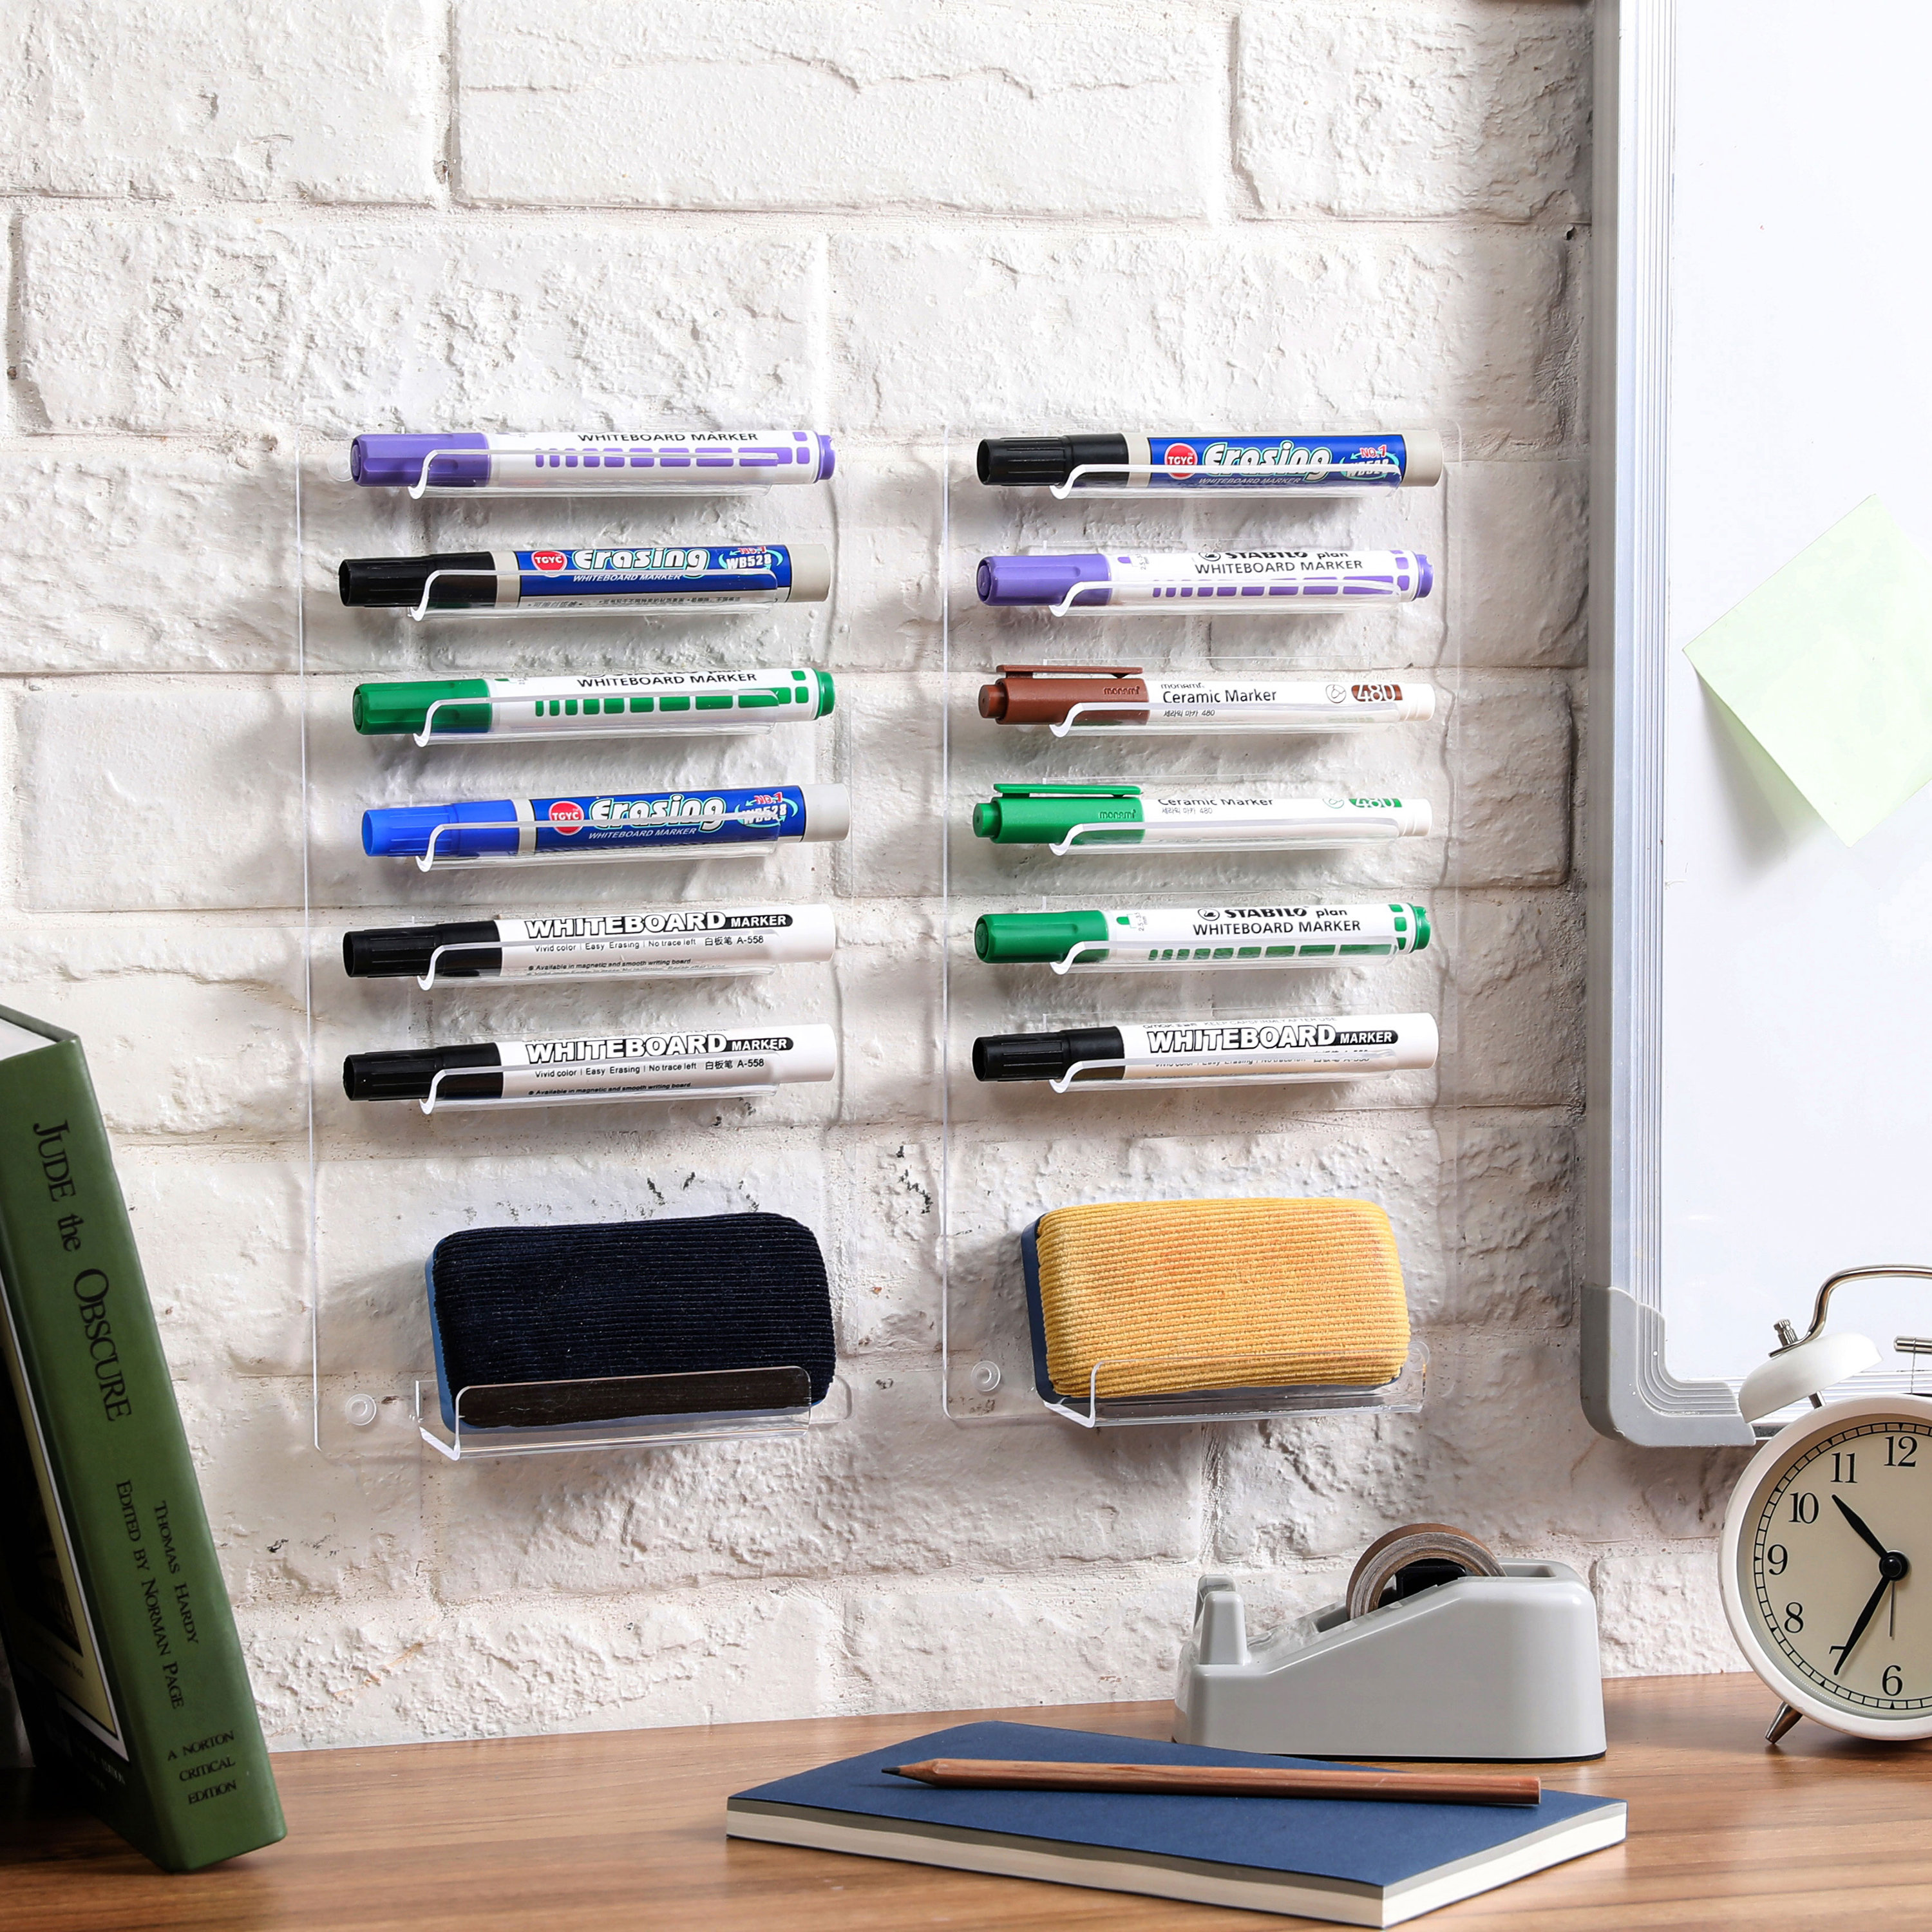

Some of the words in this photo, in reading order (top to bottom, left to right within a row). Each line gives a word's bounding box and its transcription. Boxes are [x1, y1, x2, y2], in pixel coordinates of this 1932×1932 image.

[577, 434, 685, 443] WHITEBOARD
[691, 432, 759, 442] MARKER
[1204, 440, 1332, 481] Erasing
[573, 547, 710, 578] Erasing
[726, 554, 772, 569] WB528
[1195, 562, 1295, 574] WHITEBOARD
[1300, 560, 1363, 571] MARKER
[577, 676, 685, 687] WHITEBOARD
[690, 674, 757, 683] MARKER
[1163, 690, 1221, 703] Ceramic
[1226, 688, 1276, 703] Marker
[1357, 685, 1396, 702] 480
[591, 794, 725, 831] Erasing
[1220, 797, 1274, 806] Marker
[588, 829, 653, 839] WHITEBOARD
[654, 828, 697, 837] MARKER
[524, 912, 728, 938] WHITEBOARD
[730, 914, 788, 928] MARKER
[1224, 907, 1307, 918] STABILO
[1316, 907, 1348, 918] plan
[736, 935, 764, 945] A-558
[1193, 921, 1294, 936] WHITEBOARD
[1298, 920, 1361, 933] MARKER
[556, 943, 577, 952] color
[585, 942, 605, 952] Easy
[609, 940, 640, 951] Erasing
[648, 940, 660, 948] No
[661, 939, 681, 947] trace
[683, 938, 697, 946] left
[705, 936, 734, 947] 白板笔
[525, 1034, 728, 1064] WHITEBOARD
[732, 1037, 788, 1051] MARKER
[1146, 1025, 1336, 1054] WHITEBOARD
[1340, 1030, 1393, 1045] MARKER
[535, 1069, 555, 1078] Vivid
[557, 1068, 577, 1077] color
[585, 1066, 605, 1077] Easy
[609, 1065, 641, 1075] Erasing
[649, 1064, 661, 1073] No
[661, 1064, 682, 1072] trace
[683, 1062, 697, 1071] left
[705, 1060, 734, 1070] 白板笔
[736, 1058, 765, 1068] A-558
[33, 1120, 77, 1202] JUDE
[57, 1213, 84, 1253] the
[73, 1267, 132, 1422] OBSCURE
[1884, 1435, 1918, 1468] 12
[1830, 1452, 1859, 1484] 11
[116, 1480, 142, 1543] EDITED
[1788, 1492, 1819, 1524] 10
[133, 1548, 150, 1572] BY
[1766, 1544, 1788, 1575] 9
[153, 1501, 180, 1575] THOMAS
[175, 1582, 199, 1645] HARDY
[141, 1577, 171, 1657] NORMAN
[1784, 1602, 1804, 1633] 8
[162, 1661, 185, 1710] PAGE
[1881, 1665, 1904, 1696] 6
[167, 1749, 178, 1761] A
[182, 1730, 235, 1757] NORTON
[179, 1757, 236, 1782] CRITICAL
[187, 1780, 237, 1804] EDITION
